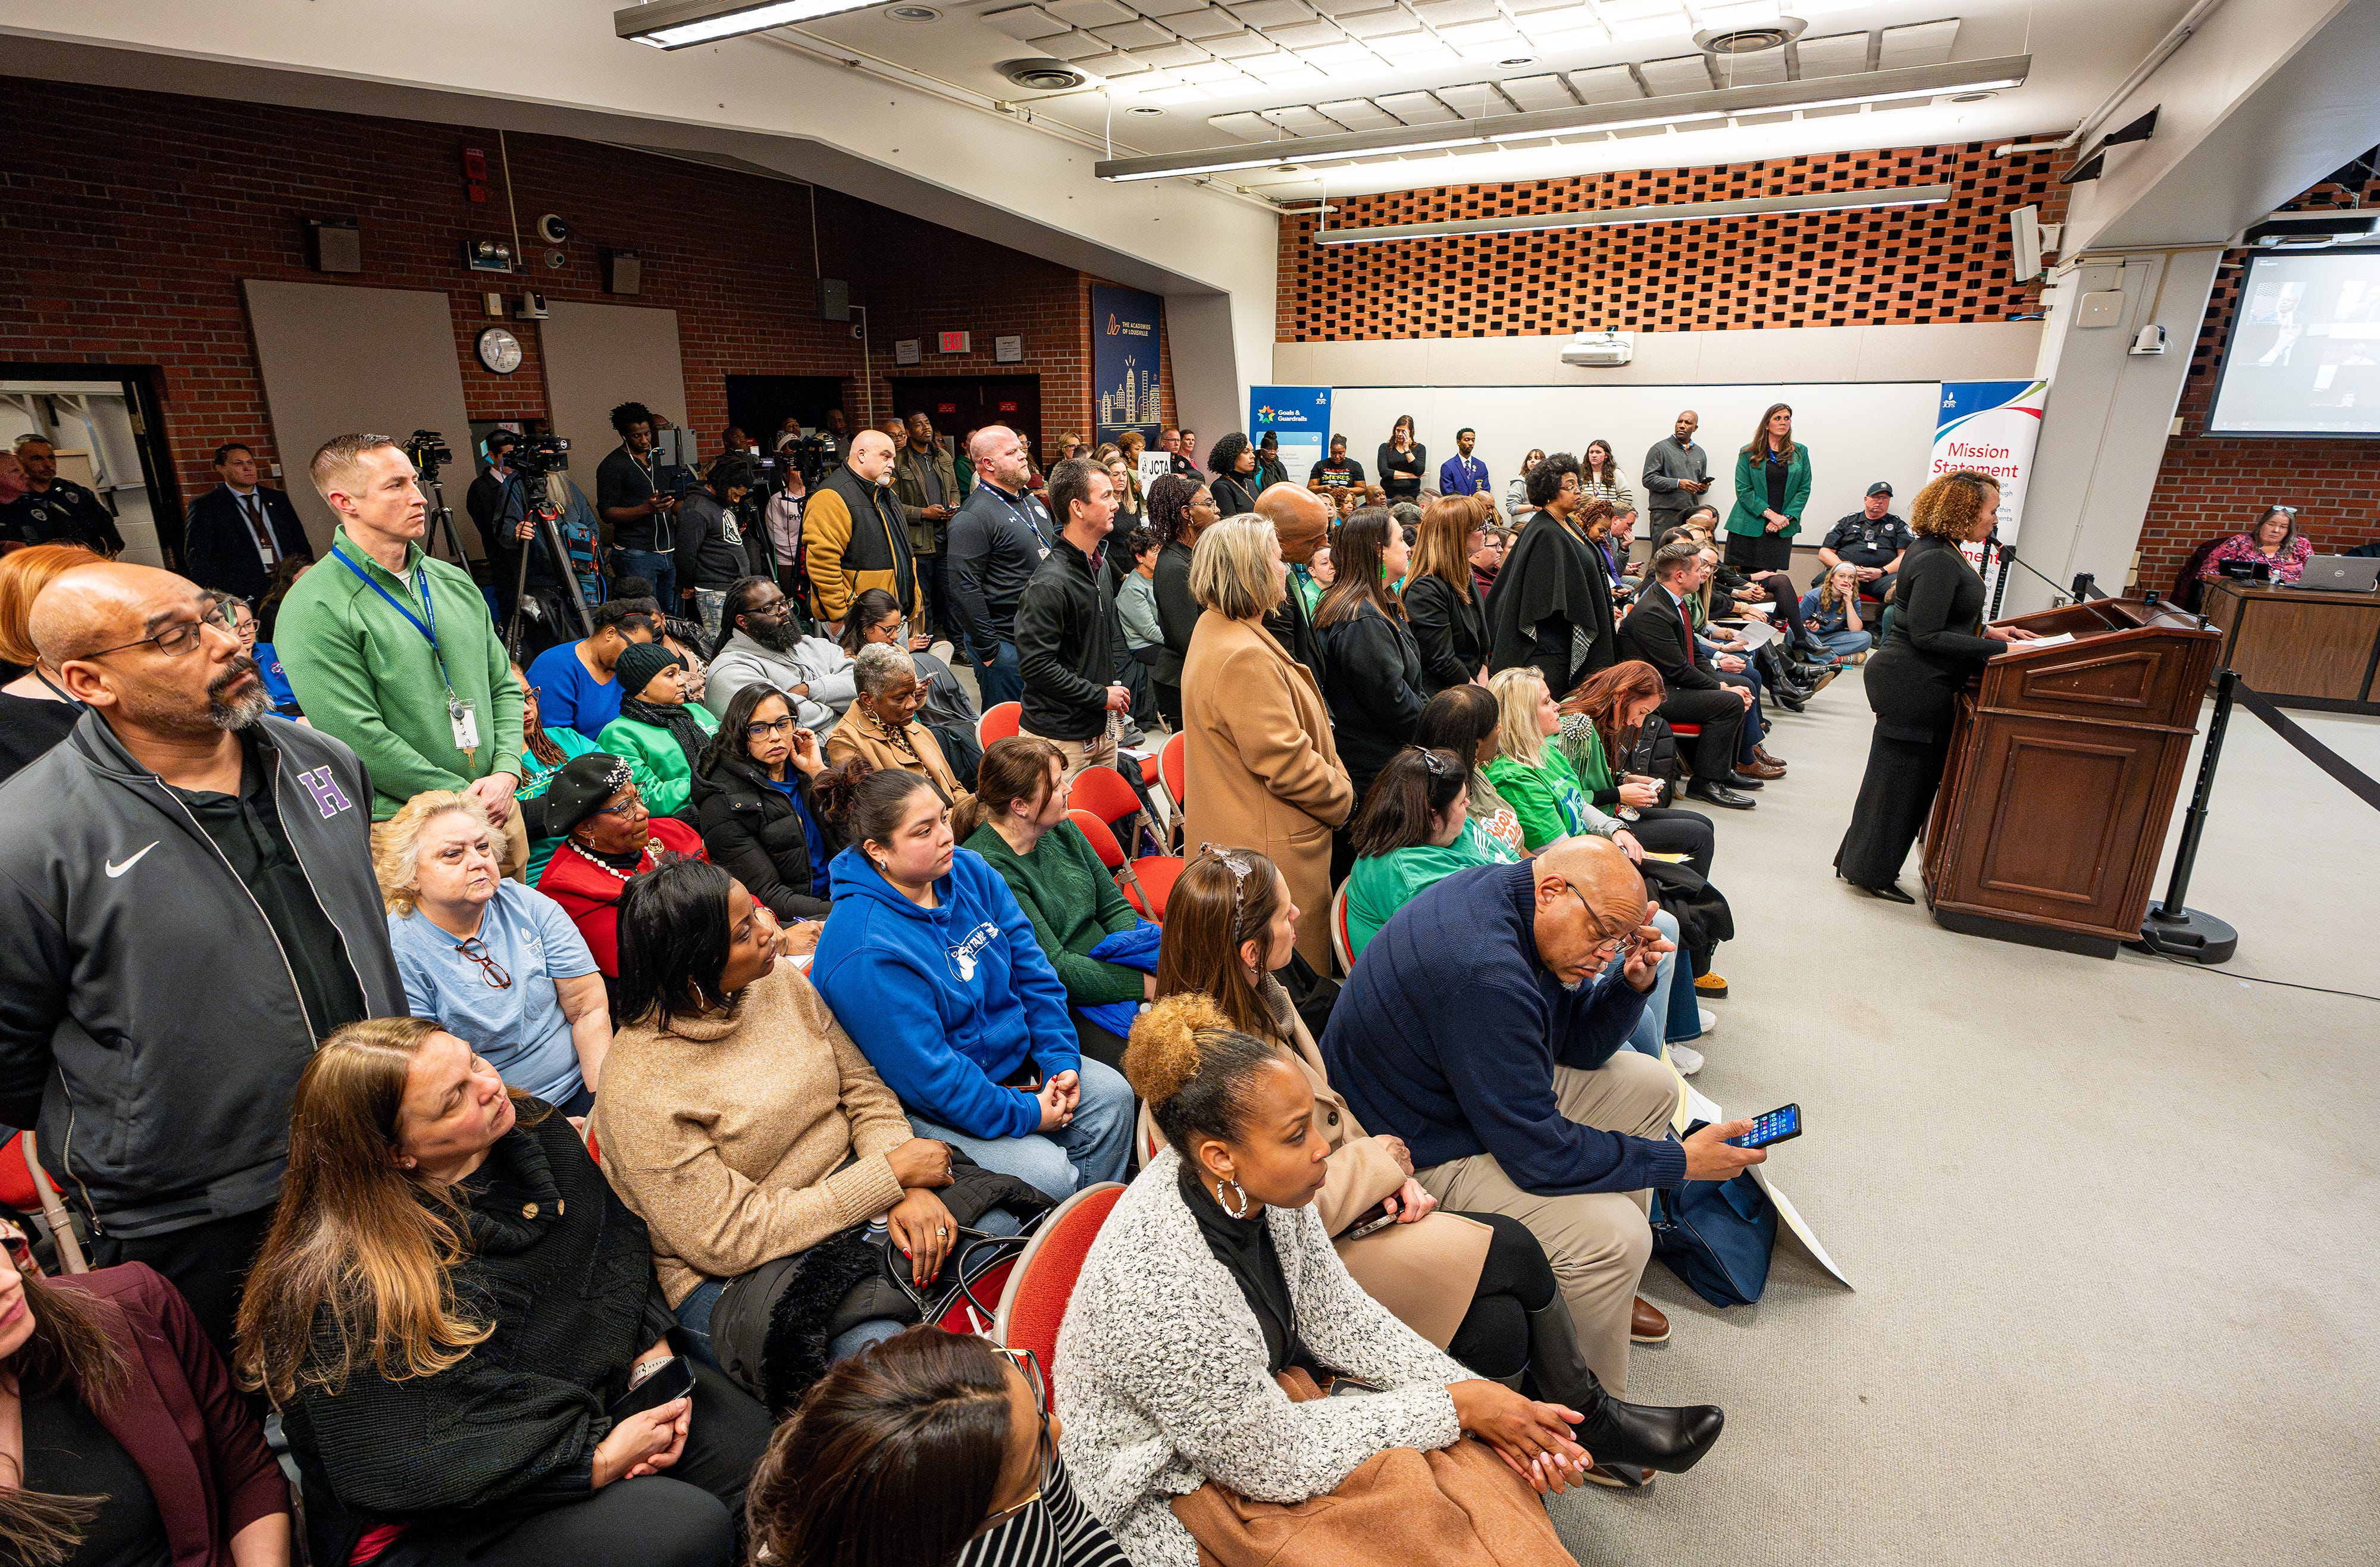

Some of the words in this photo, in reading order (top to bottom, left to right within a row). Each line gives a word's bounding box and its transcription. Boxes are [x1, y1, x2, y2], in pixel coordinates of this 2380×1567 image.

[944, 331, 962, 351] EXIT
[1947, 442, 2009, 459] Mission
[1150, 460, 1169, 476] JCTA
[297, 765, 352, 820] H
